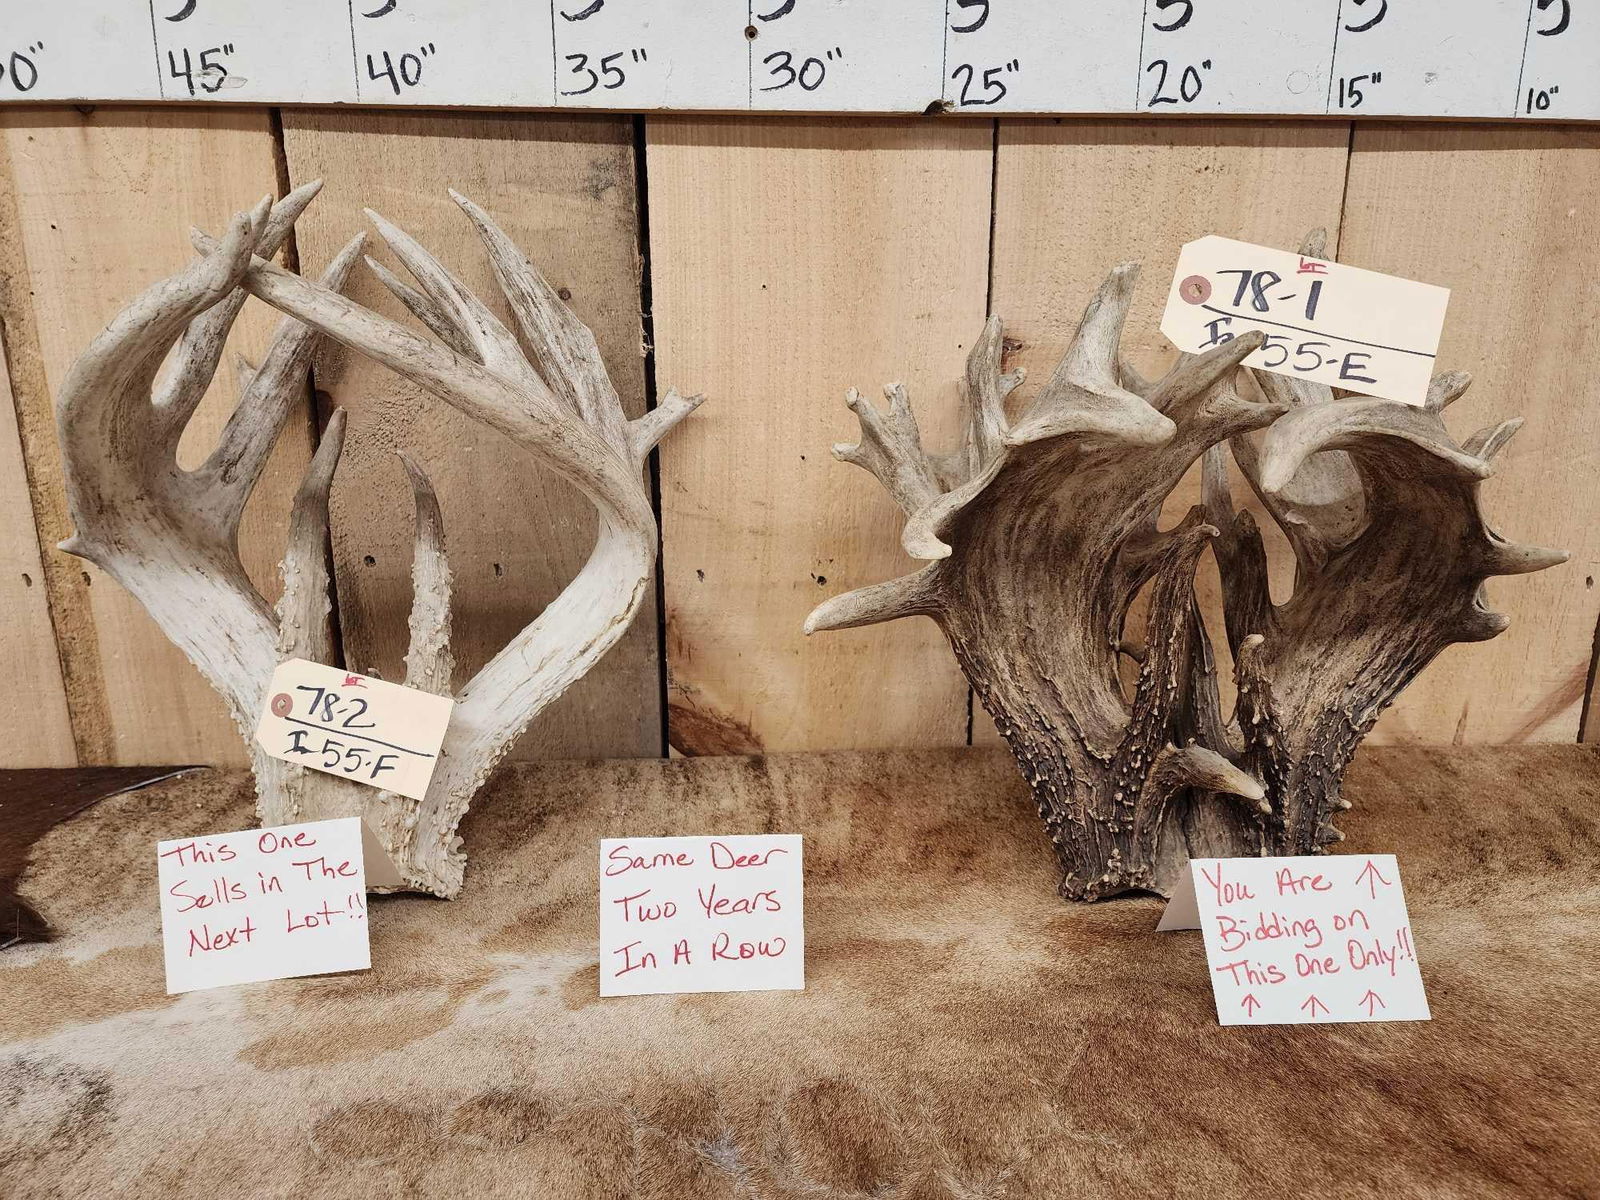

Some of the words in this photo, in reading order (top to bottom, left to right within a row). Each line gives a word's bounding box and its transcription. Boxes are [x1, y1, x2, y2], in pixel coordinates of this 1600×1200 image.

[0, 40, 44, 92] 0"
[168, 43, 235, 96] 45"
[366, 43, 436, 95] 40"
[560, 48, 647, 96] 35"
[759, 47, 843, 92] 30"
[952, 59, 1020, 107] 25"
[1147, 59, 1211, 108] 20"
[1338, 72, 1381, 109] 15"
[1527, 85, 1559, 114] 10"
[1216, 270, 1323, 321] 78-1
[296, 685, 376, 729] 78-2
[160, 842, 236, 867] This
[258, 832, 316, 854] One
[605, 845, 694, 876] Same
[710, 841, 789, 870] Deer
[169, 876, 247, 912] Sells
[258, 871, 283, 894] in
[291, 857, 358, 881] The
[613, 889, 677, 922] Two
[698, 883, 782, 919] Years
[1201, 862, 1255, 907] You
[1275, 867, 1333, 896] Are
[188, 916, 256, 958] Next
[1215, 911, 1323, 952] Bidding
[1333, 909, 1370, 931] on
[613, 940, 657, 977] In
[673, 938, 691, 965] A
[1215, 959, 1286, 986] This
[1294, 953, 1341, 977] One
[1347, 926, 1415, 977] Only!!
